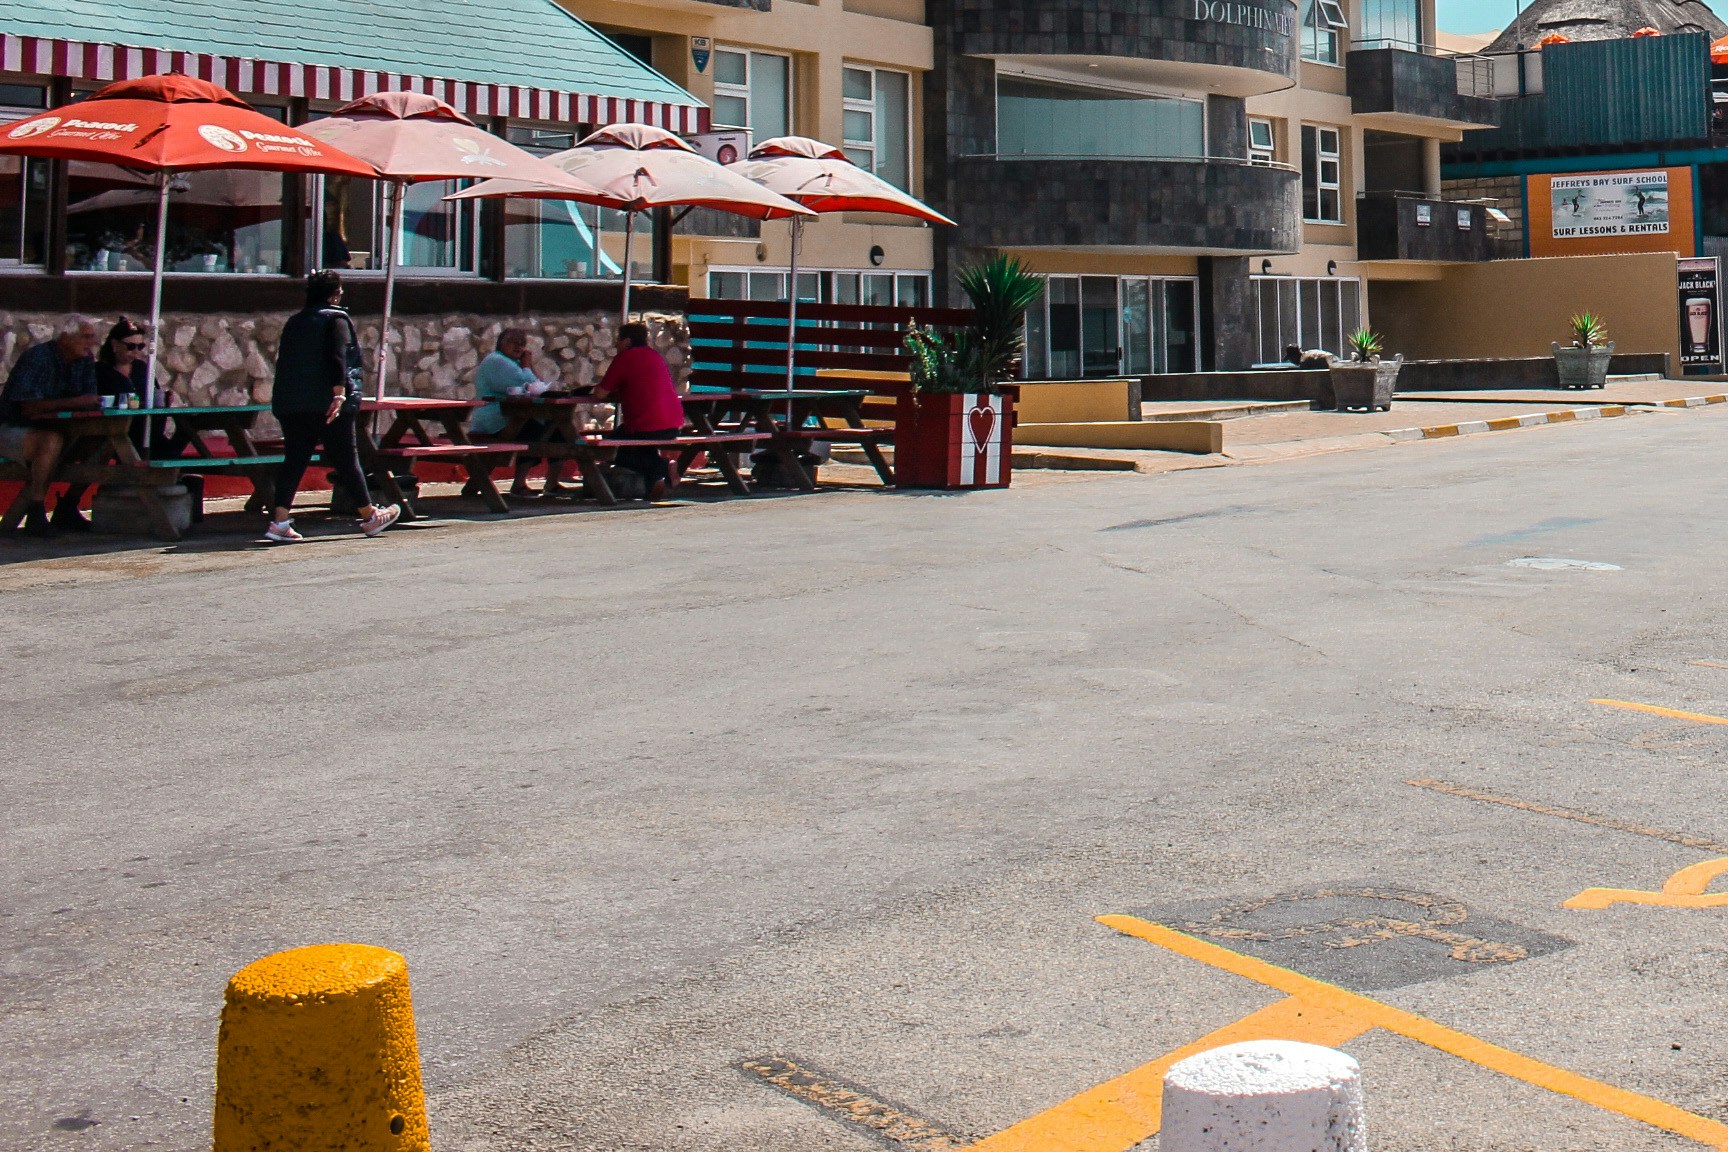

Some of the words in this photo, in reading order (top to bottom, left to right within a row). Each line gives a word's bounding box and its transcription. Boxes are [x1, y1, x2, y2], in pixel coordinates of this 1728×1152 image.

[61, 119, 139, 133] Peacock
[1552, 179, 1591, 189] JEFFREYS
[1593, 178, 1610, 186] BAY
[1612, 177, 1634, 185] SURF
[1636, 175, 1667, 184] SCHOOL
[1553, 228, 1577, 236] SURF
[1579, 226, 1617, 235] LESSONS
[1628, 223, 1668, 233] RENTALS
[1679, 281, 1695, 290] JACK
[1680, 354, 1720, 362] OPEN
